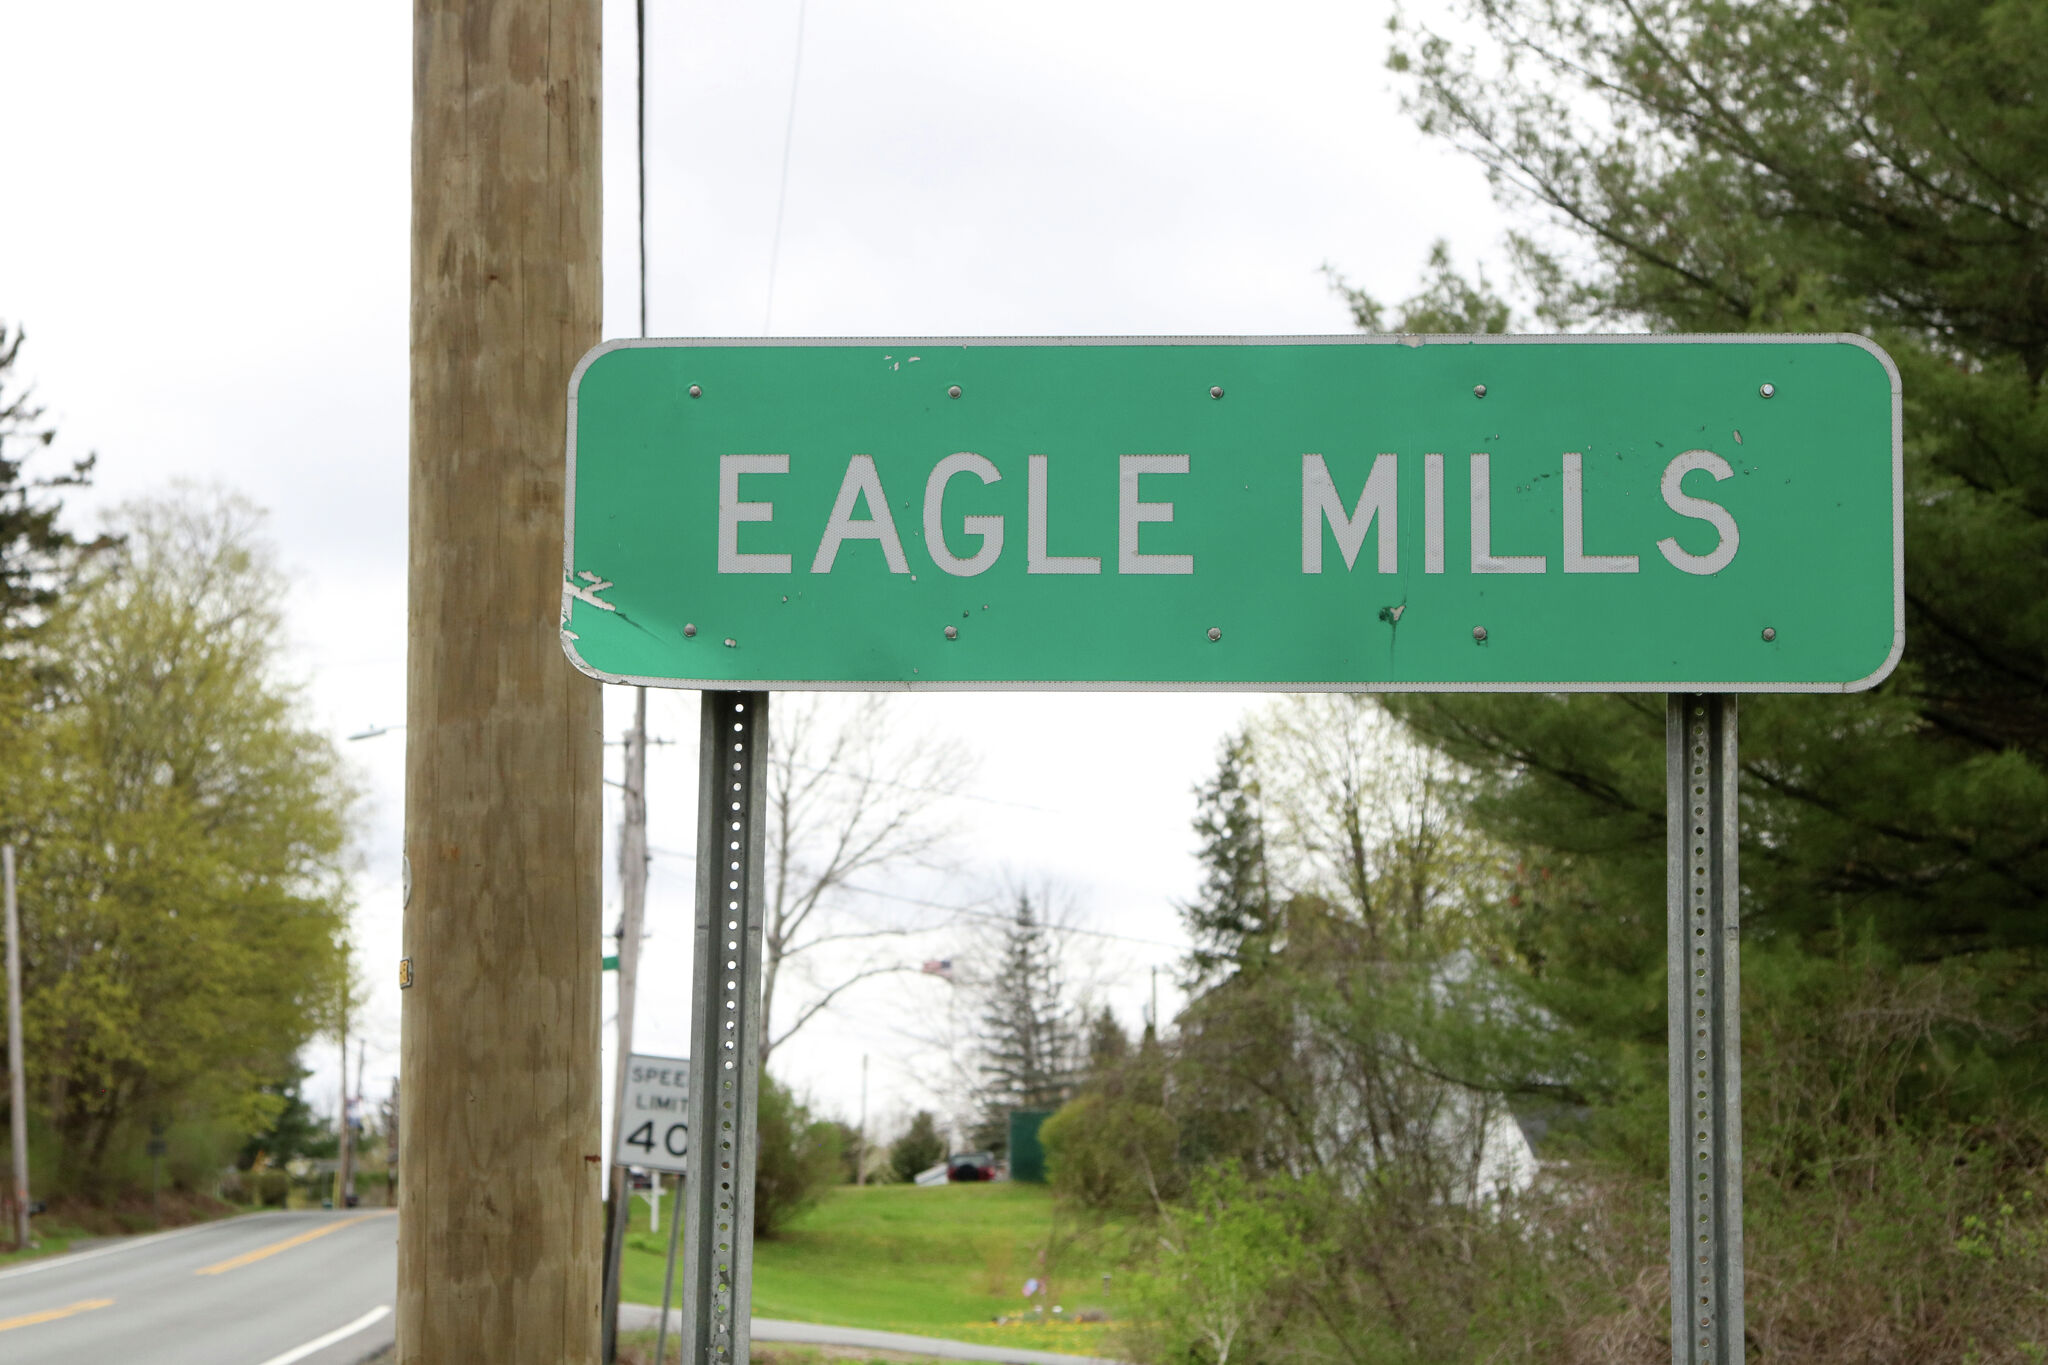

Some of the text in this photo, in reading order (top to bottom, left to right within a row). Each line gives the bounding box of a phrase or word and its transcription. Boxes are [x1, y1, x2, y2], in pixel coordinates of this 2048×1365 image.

[717, 450, 1741, 576] EAGLE MILLS
[632, 1066, 689, 1087] SPEE
[635, 1093, 688, 1112] LIMIT
[626, 1119, 688, 1157] 40
